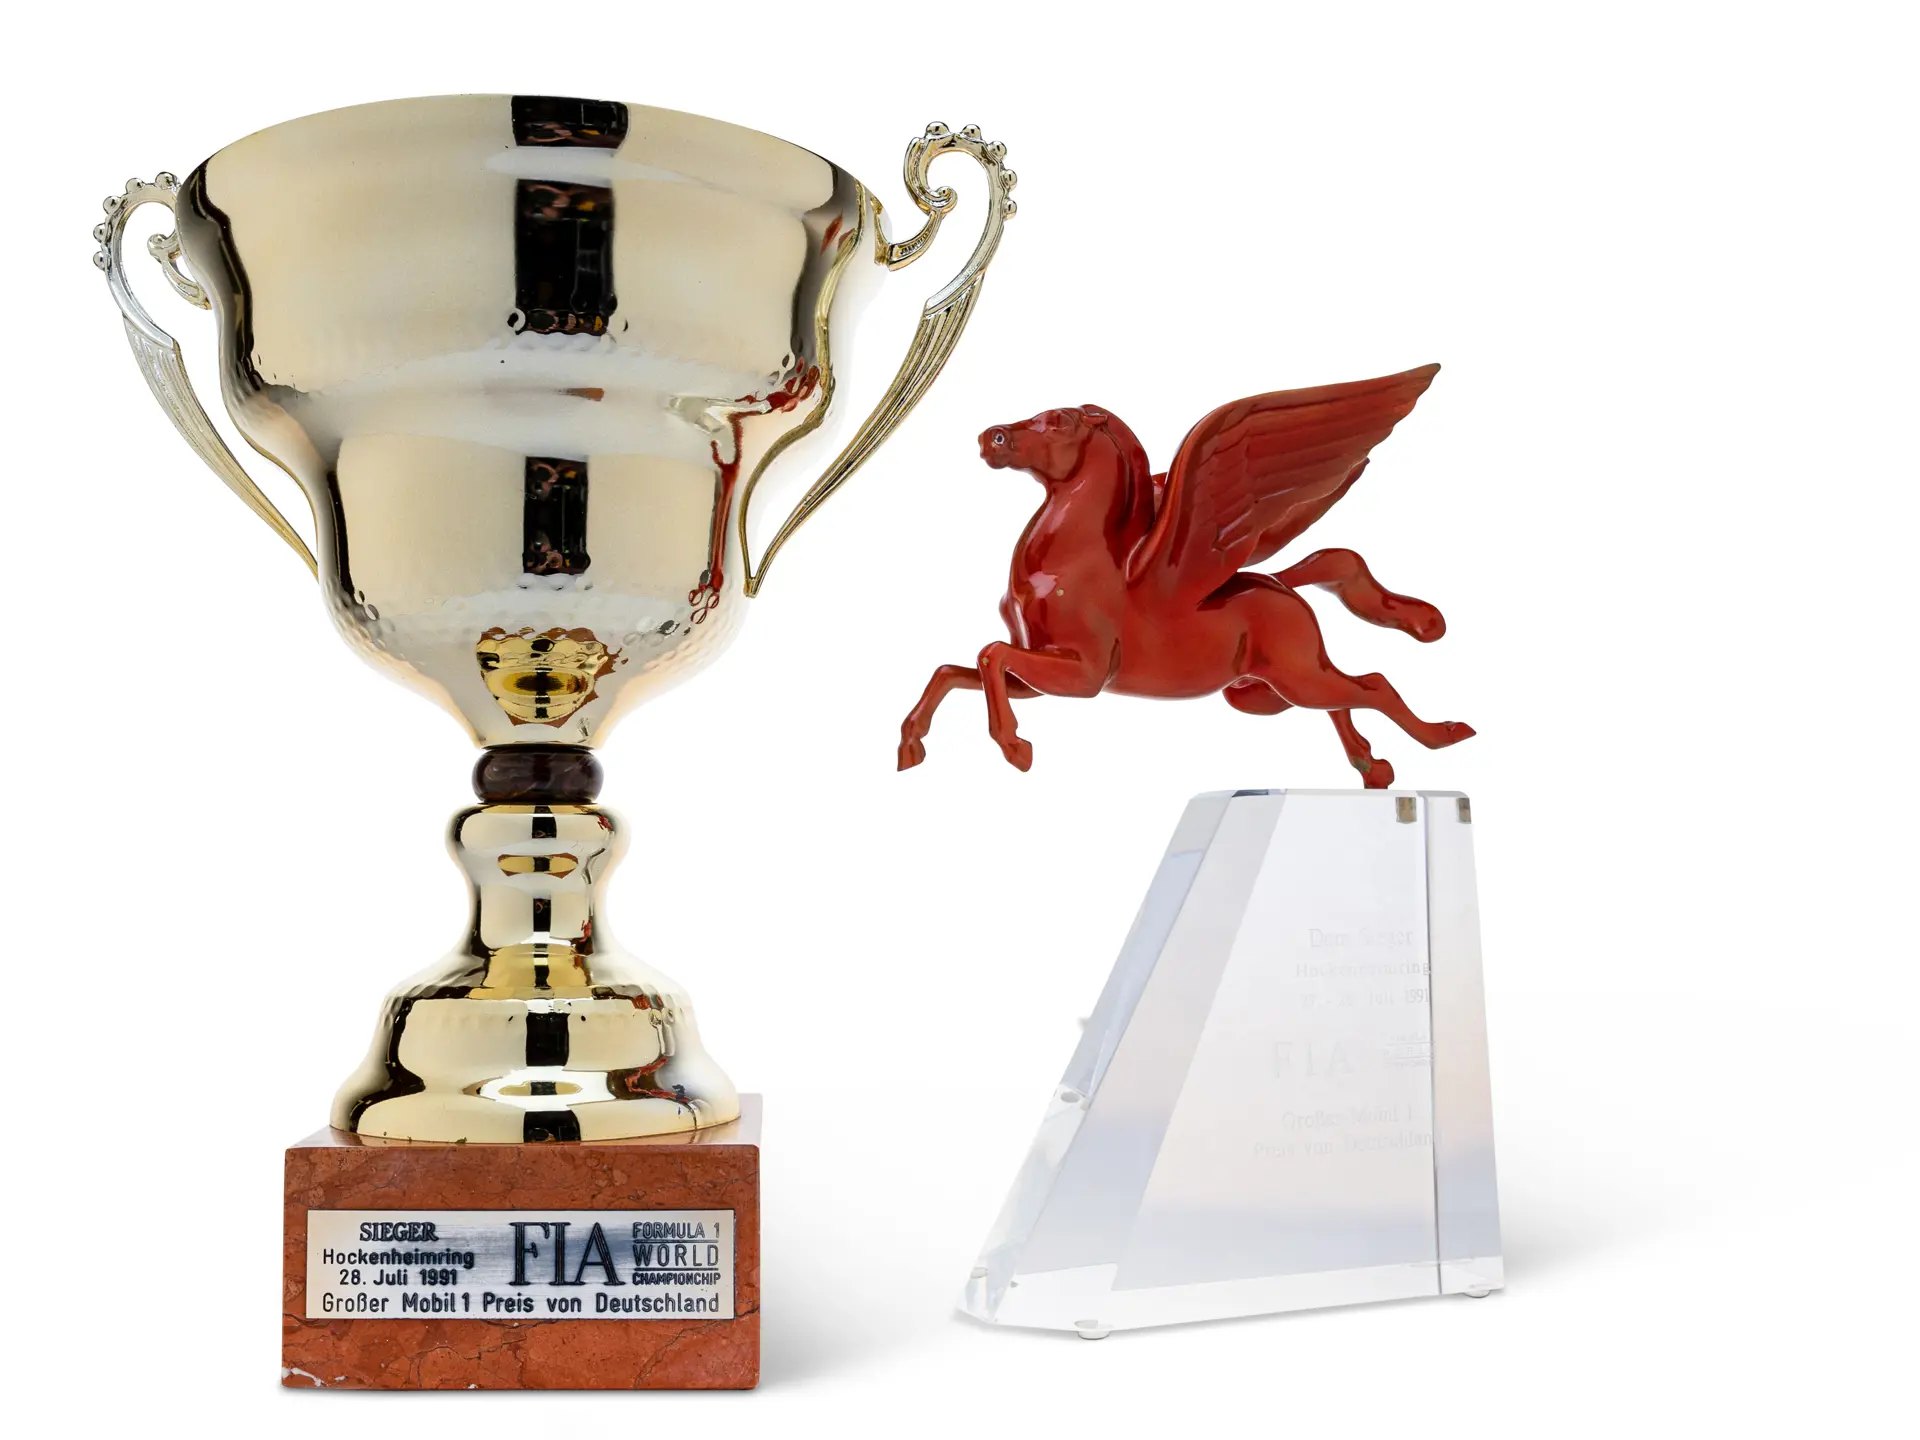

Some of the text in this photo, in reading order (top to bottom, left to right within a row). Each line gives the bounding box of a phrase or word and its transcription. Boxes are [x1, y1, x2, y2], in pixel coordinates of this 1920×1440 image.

[1405, 988, 1430, 1004] 1991
[1273, 1039, 1355, 1079] FIA
[1305, 1141, 1334, 1156] von
[359, 1222, 439, 1242] SIEGER
[632, 1221, 720, 1239] FORMULA 1
[323, 1248, 475, 1270] Hockenheimring
[509, 1222, 626, 1287] FIA
[632, 1244, 719, 1267] WORLD
[339, 1269, 459, 1286] 28. Juli 1991
[323, 1293, 720, 1314] Großer Mobil 1 Preis von Deutschland
